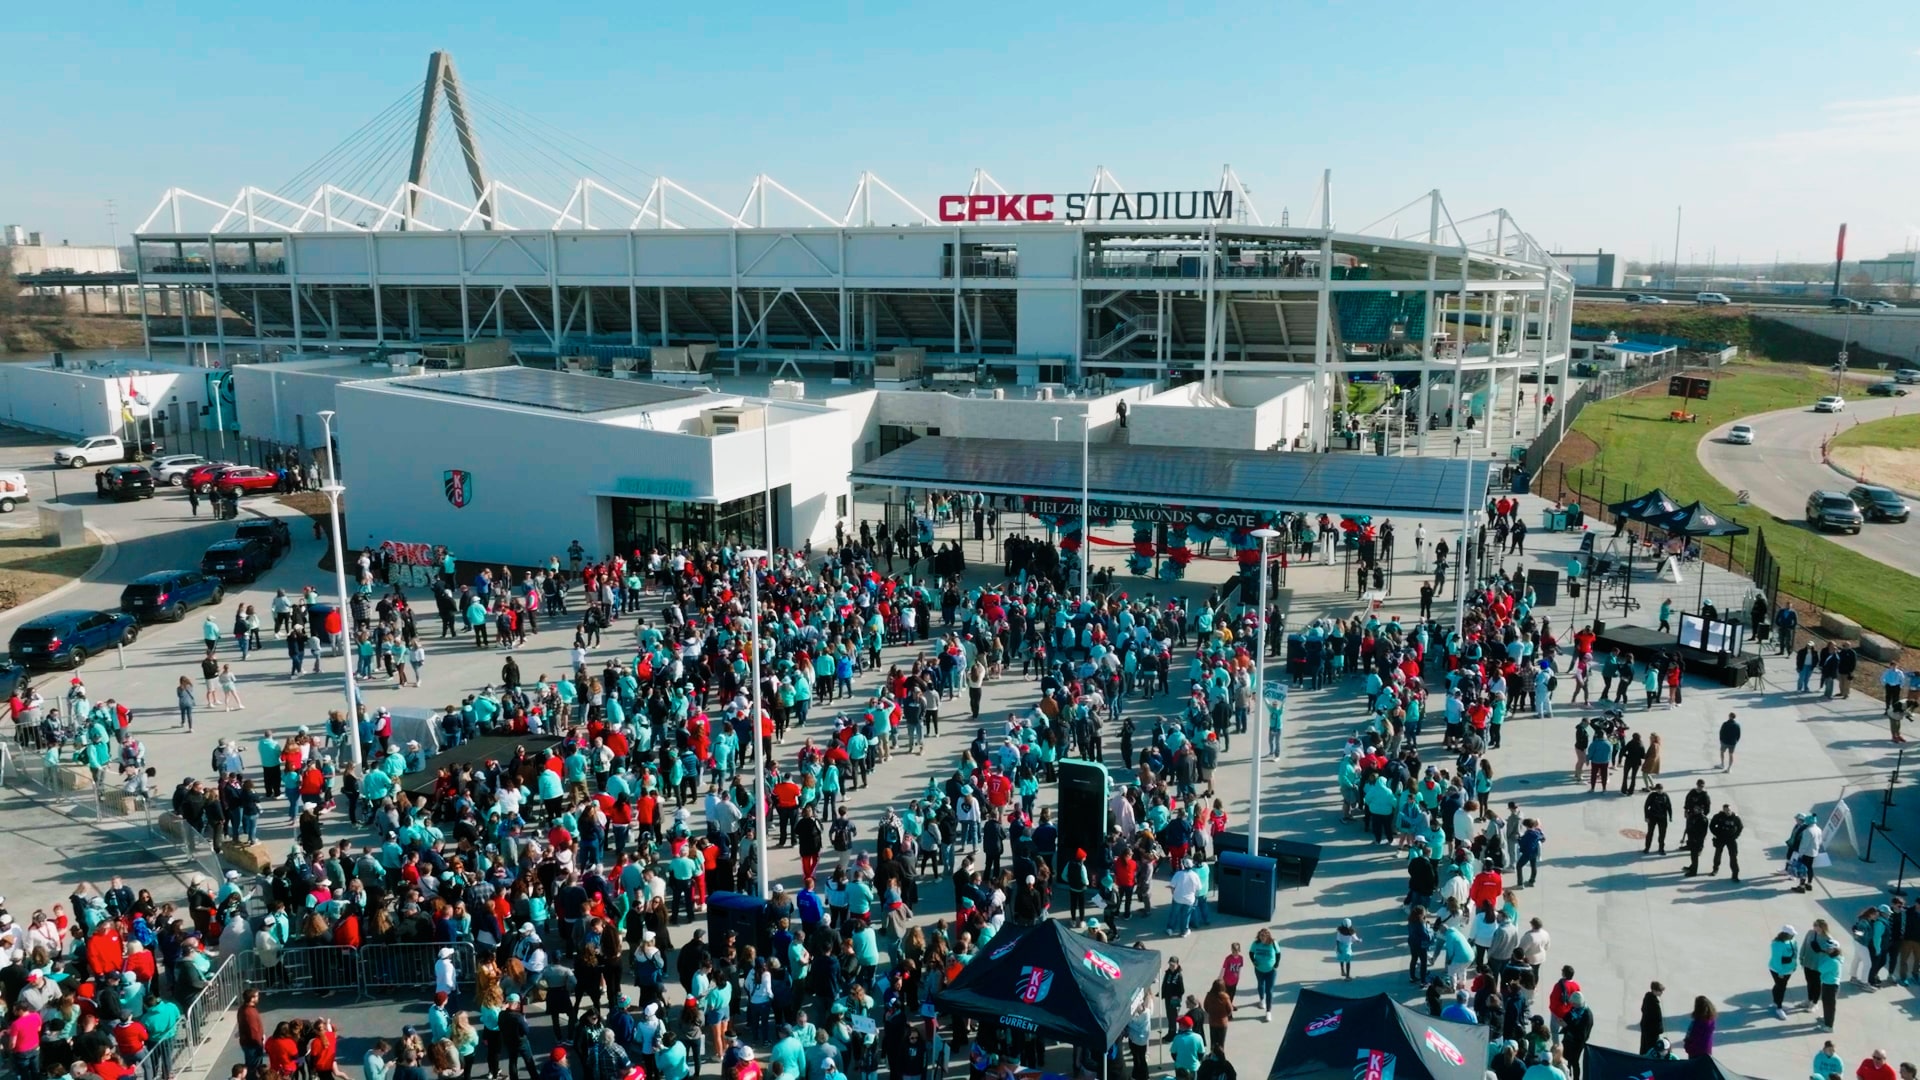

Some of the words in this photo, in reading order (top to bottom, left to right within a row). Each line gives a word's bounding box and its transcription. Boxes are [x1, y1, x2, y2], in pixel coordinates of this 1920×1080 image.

[939, 194, 1054, 221] CPKC
[1066, 190, 1233, 220] STADIUM
[1032, 501, 1108, 517] HELZBRG
[1113, 504, 1193, 523] DIAMONDS
[1216, 513, 1256, 527] GATE
[993, 782, 1000, 792] 17
[1026, 970, 1042, 1000] KC
[1000, 1015, 1039, 1033] CURRENT
